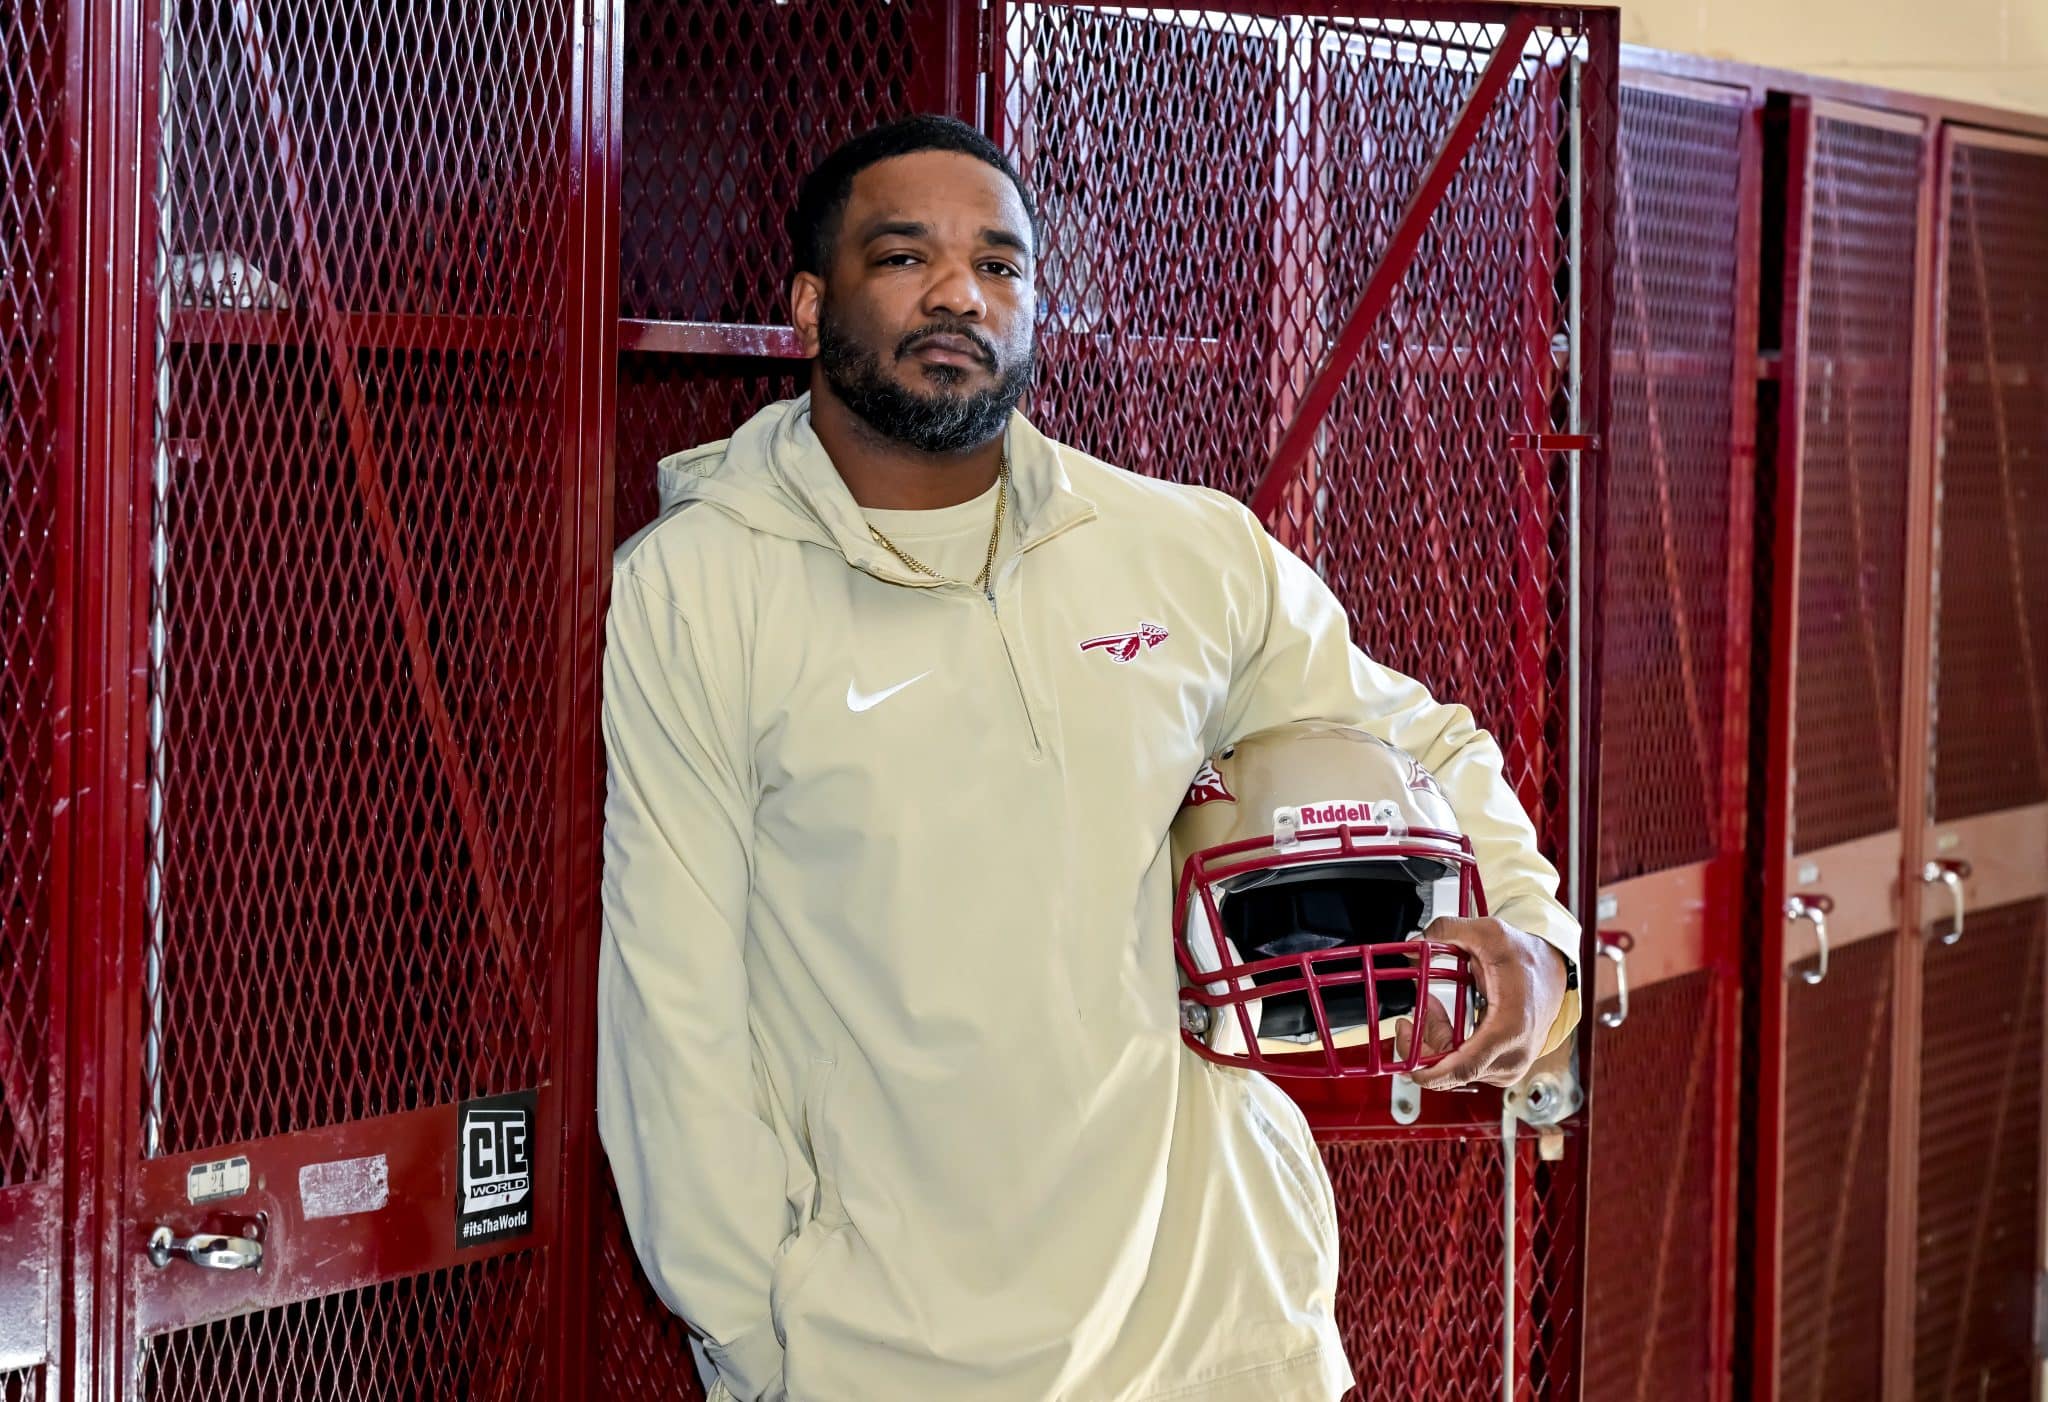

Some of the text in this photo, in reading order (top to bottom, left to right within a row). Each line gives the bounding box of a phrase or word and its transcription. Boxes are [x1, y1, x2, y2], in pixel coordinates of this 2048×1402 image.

[1301, 803, 1371, 825] Riddell
[469, 1111, 528, 1179] CTE
[472, 1179, 526, 1197] WORLD
[462, 1210, 527, 1238] #itsThaWorld
